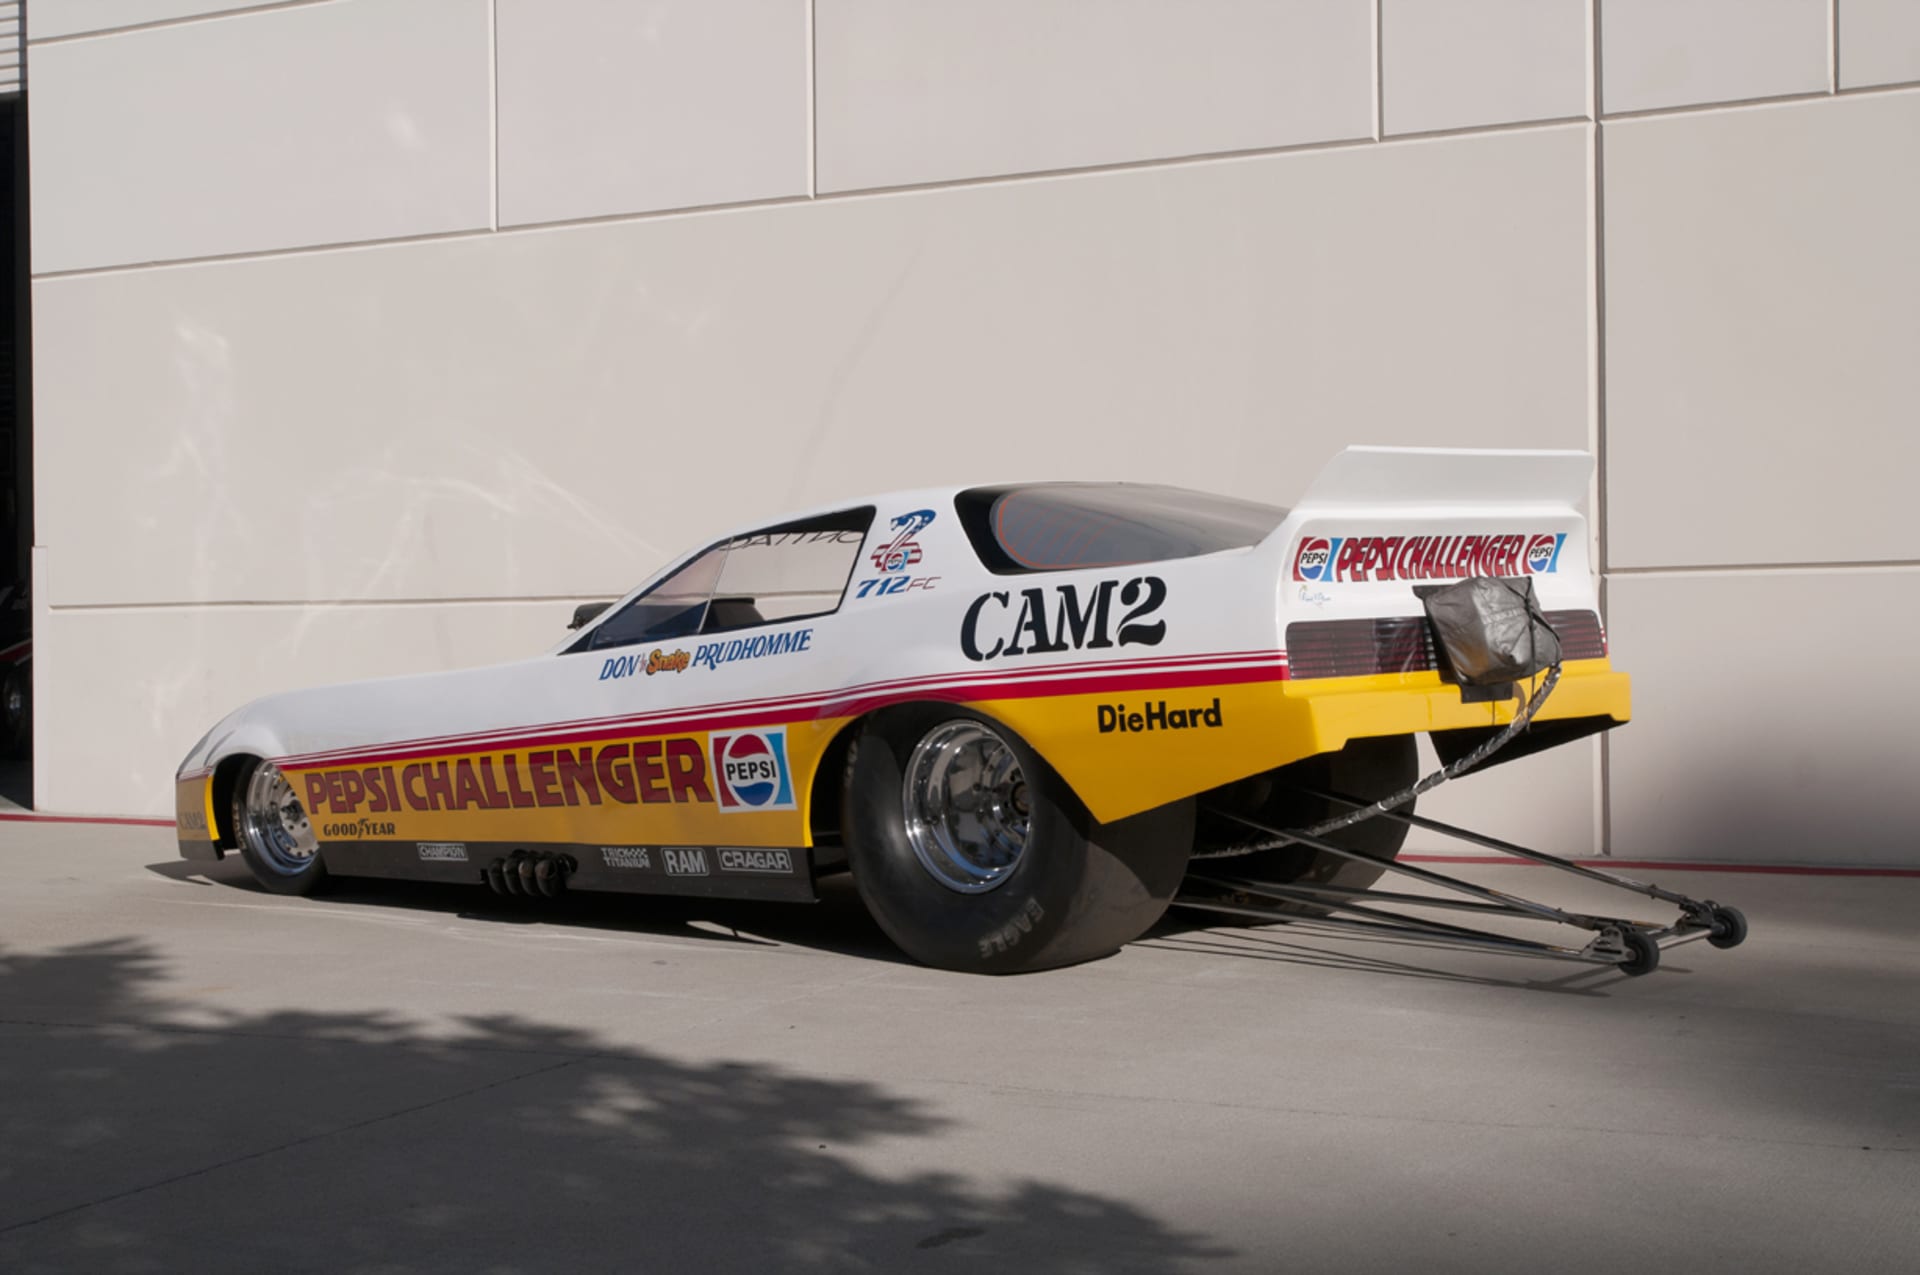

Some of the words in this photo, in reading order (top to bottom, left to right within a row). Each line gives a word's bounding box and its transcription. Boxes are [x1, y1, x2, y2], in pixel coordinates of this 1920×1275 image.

[1300, 552, 1328, 565] PEPSI
[1336, 536, 1403, 582] PEPSI
[1396, 534, 1526, 580] CHALLENGER
[1529, 545, 1554, 560] PEPSI
[960, 576, 1167, 661] CAM2
[598, 655, 639, 681] DON
[646, 648, 691, 676] Snake
[692, 628, 813, 670] PRUDHOMME
[1097, 698, 1223, 734] DieHard
[305, 765, 402, 815] PEPSI
[402, 738, 715, 813] CHALLENGER
[726, 760, 777, 781] PEPSI
[323, 818, 396, 839] GOODYEAR
[420, 845, 465, 858] CHAMPION
[663, 850, 707, 874] RAM
[721, 852, 790, 870] CRAGAR
